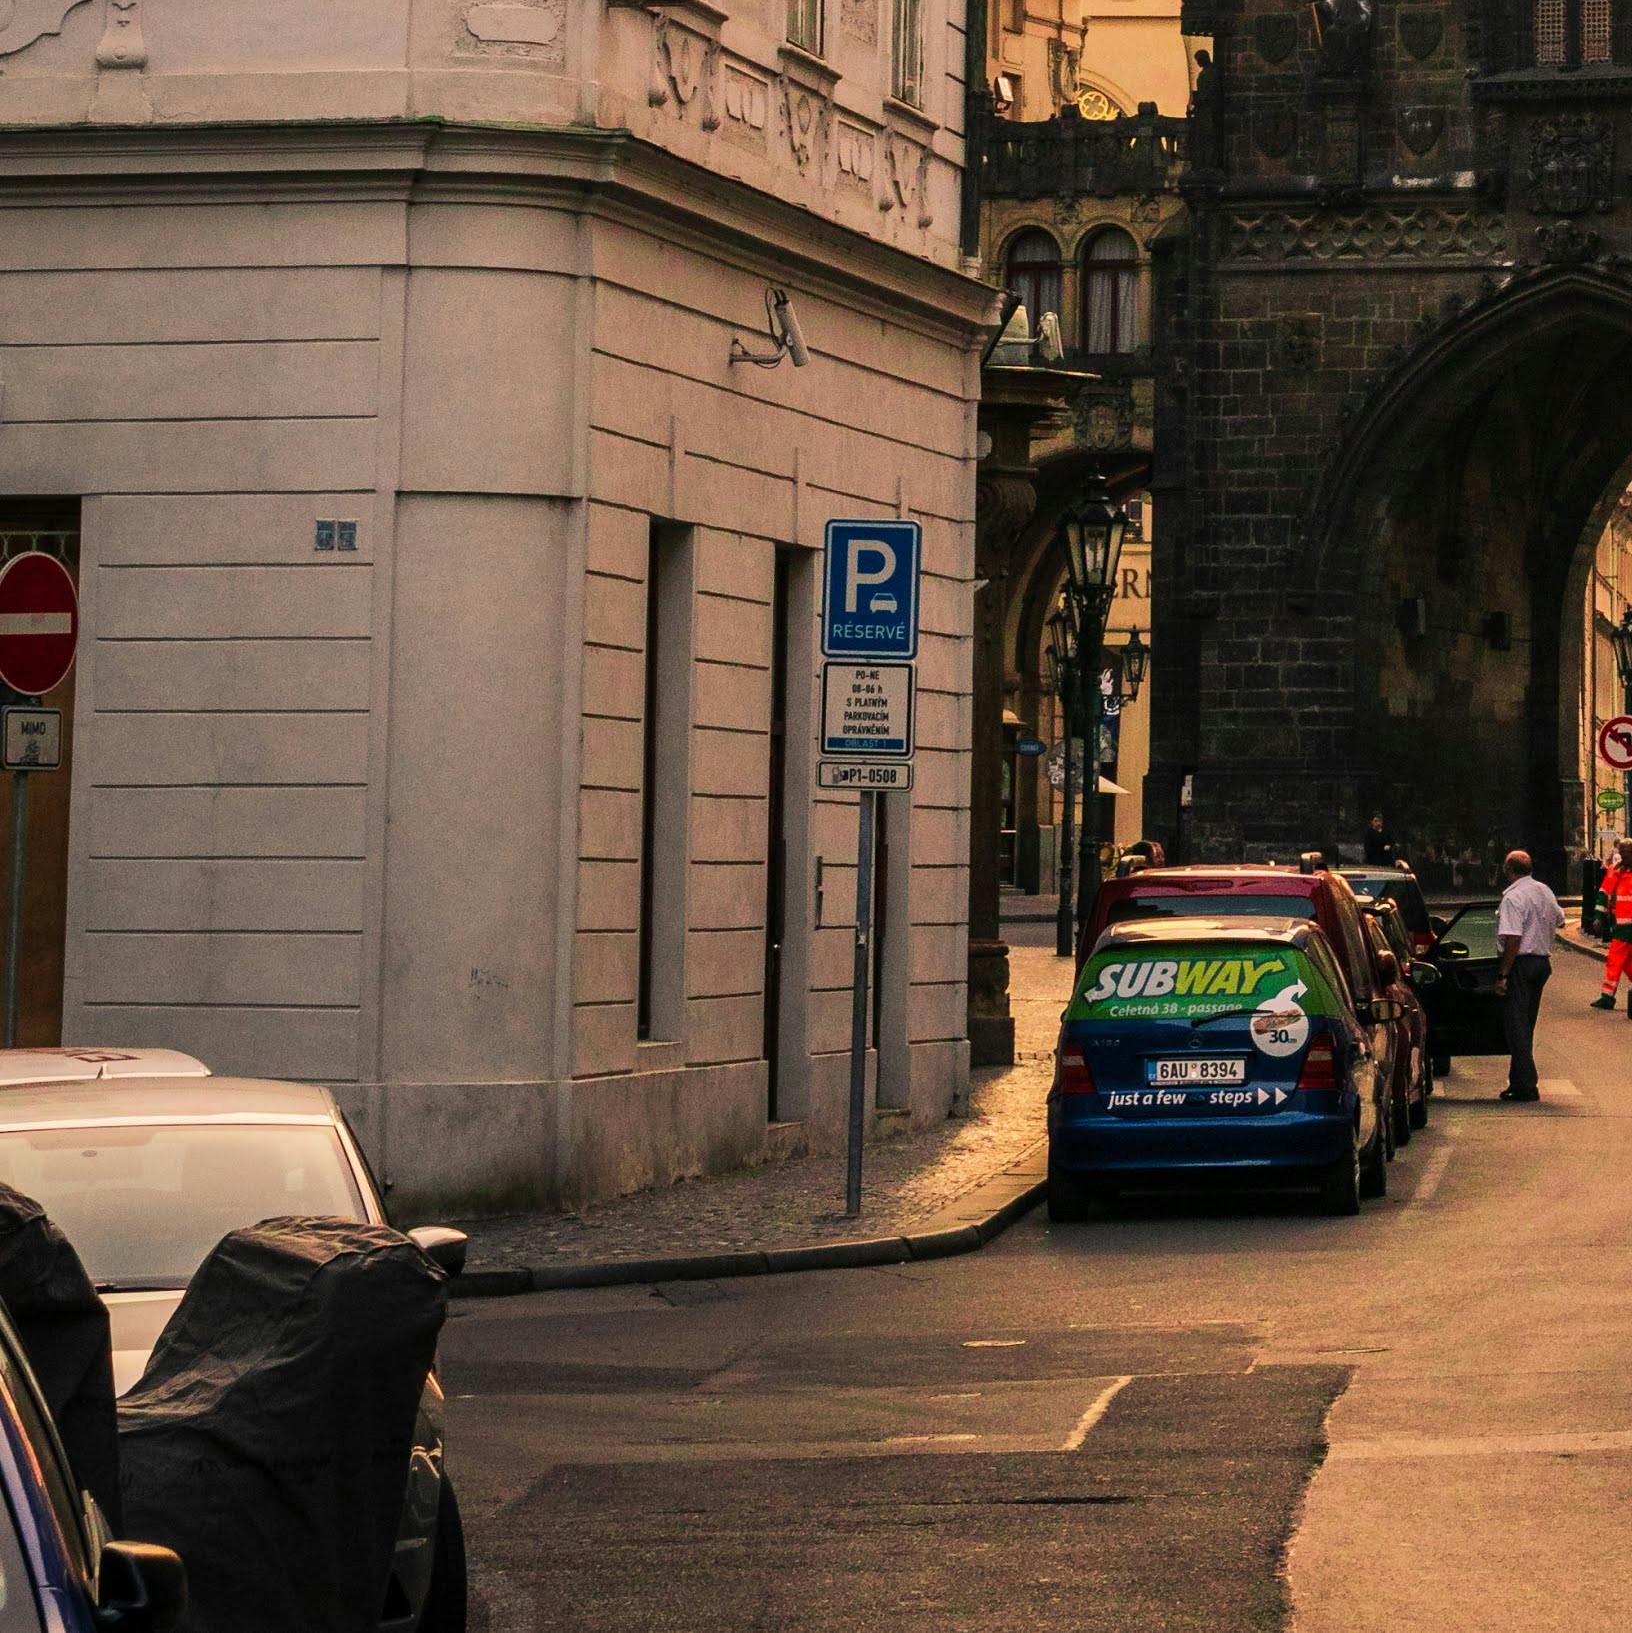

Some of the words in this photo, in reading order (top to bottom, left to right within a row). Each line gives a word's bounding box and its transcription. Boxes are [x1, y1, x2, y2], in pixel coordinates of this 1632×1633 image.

[844, 538, 897, 613] P
[832, 620, 906, 640] RÉSERVÉ
[855, 670, 881, 680] PO-NE
[846, 697, 852, 707] S
[854, 695, 888, 708] PLATNÝM
[849, 767, 897, 784] P1-0508
[1086, 959, 1284, 1002] SUBWAY
[1109, 1003, 1160, 1018] Celetná
[1161, 1003, 1178, 1015] 38
[1160, 1062, 1188, 1079] 6AU
[1199, 1061, 1238, 1078] 8394
[1107, 1090, 1140, 1110] just
[1142, 1093, 1153, 1105] a
[1156, 1089, 1187, 1105] few
[1209, 1089, 1254, 1108] steps
